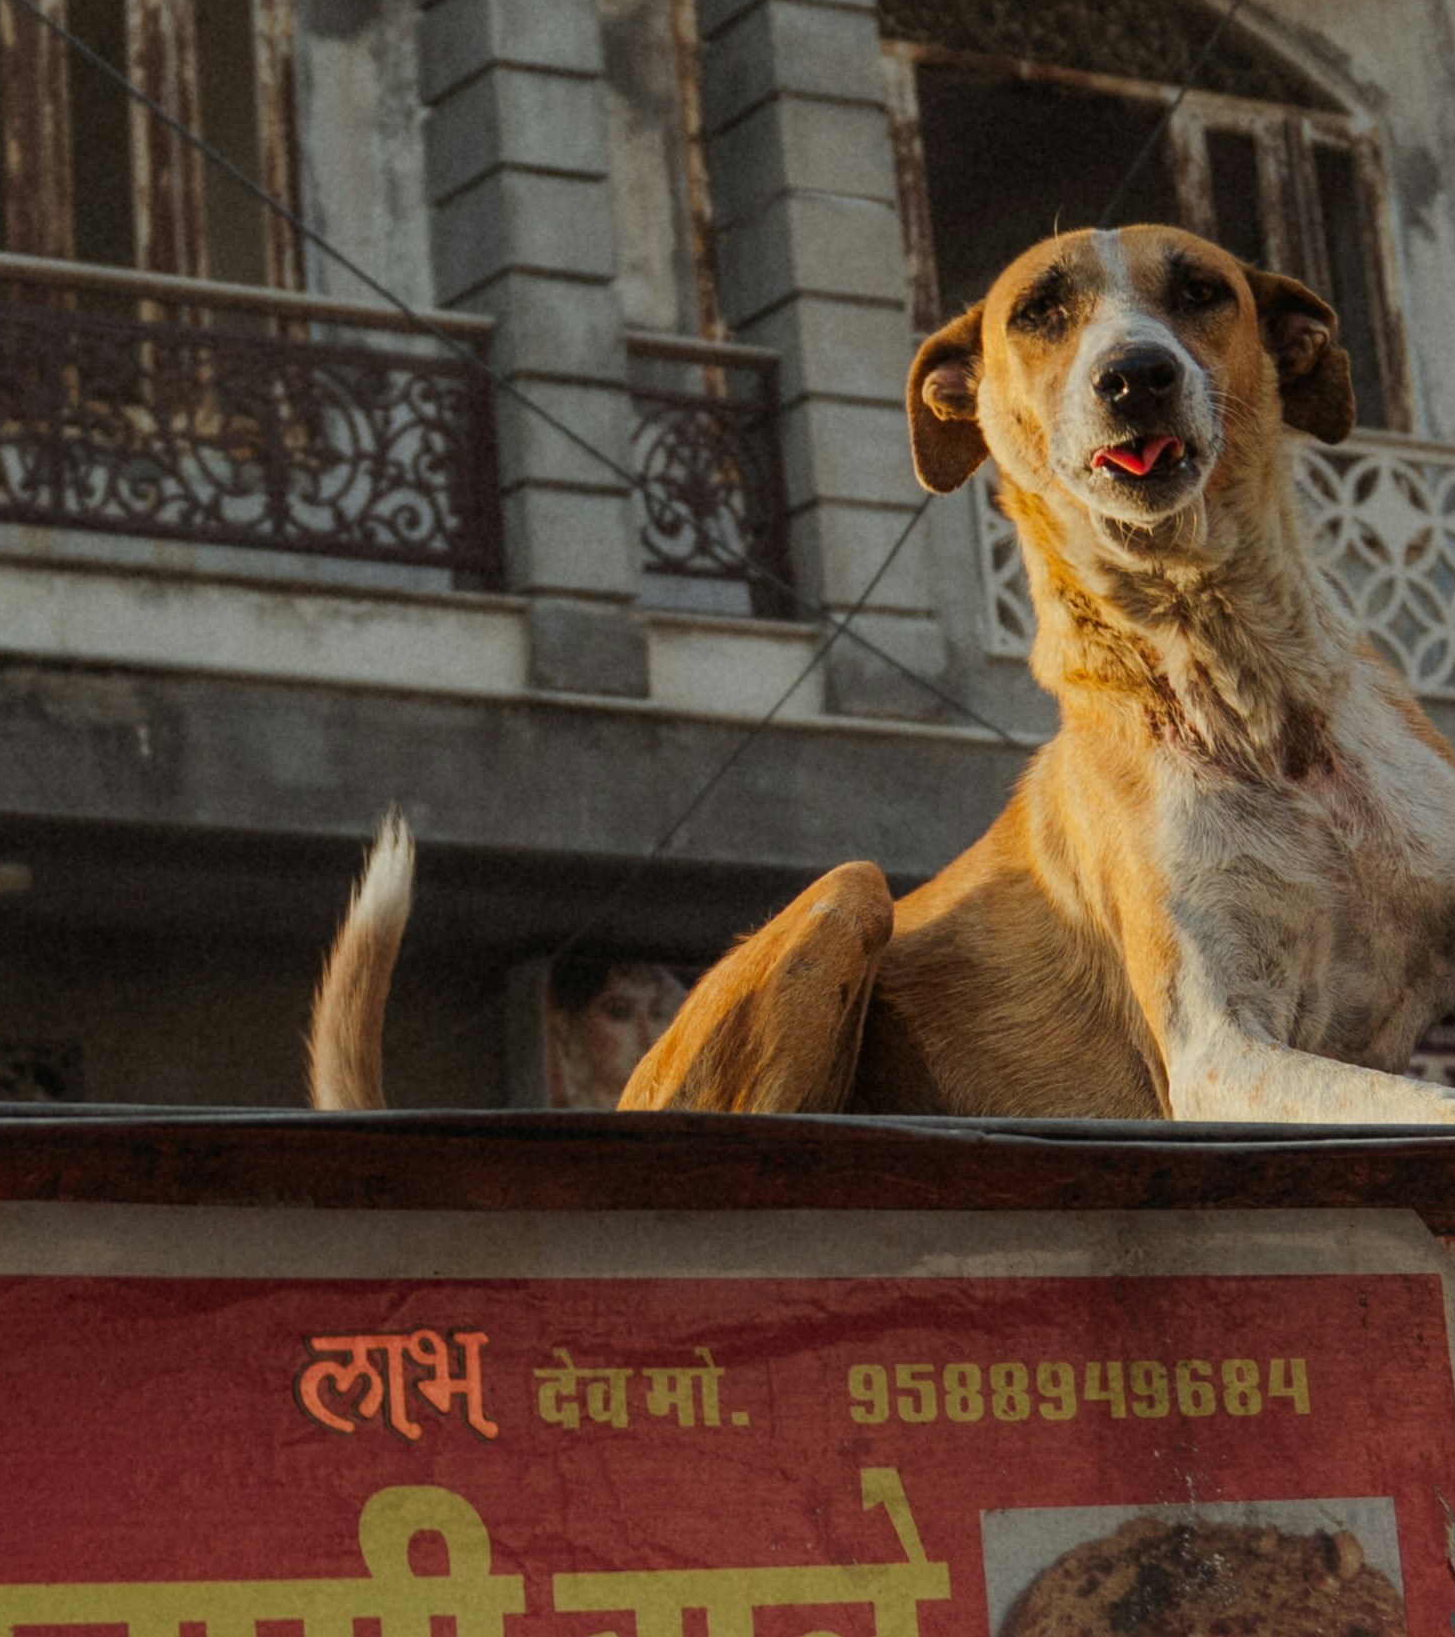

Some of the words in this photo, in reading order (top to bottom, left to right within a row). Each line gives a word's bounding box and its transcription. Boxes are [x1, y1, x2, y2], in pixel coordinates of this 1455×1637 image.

[295, 1325, 499, 1443] लाभ
[534, 1347, 634, 1429] देव
[642, 1347, 751, 1427] मो.
[848, 1357, 1311, 1425] 9588949684
